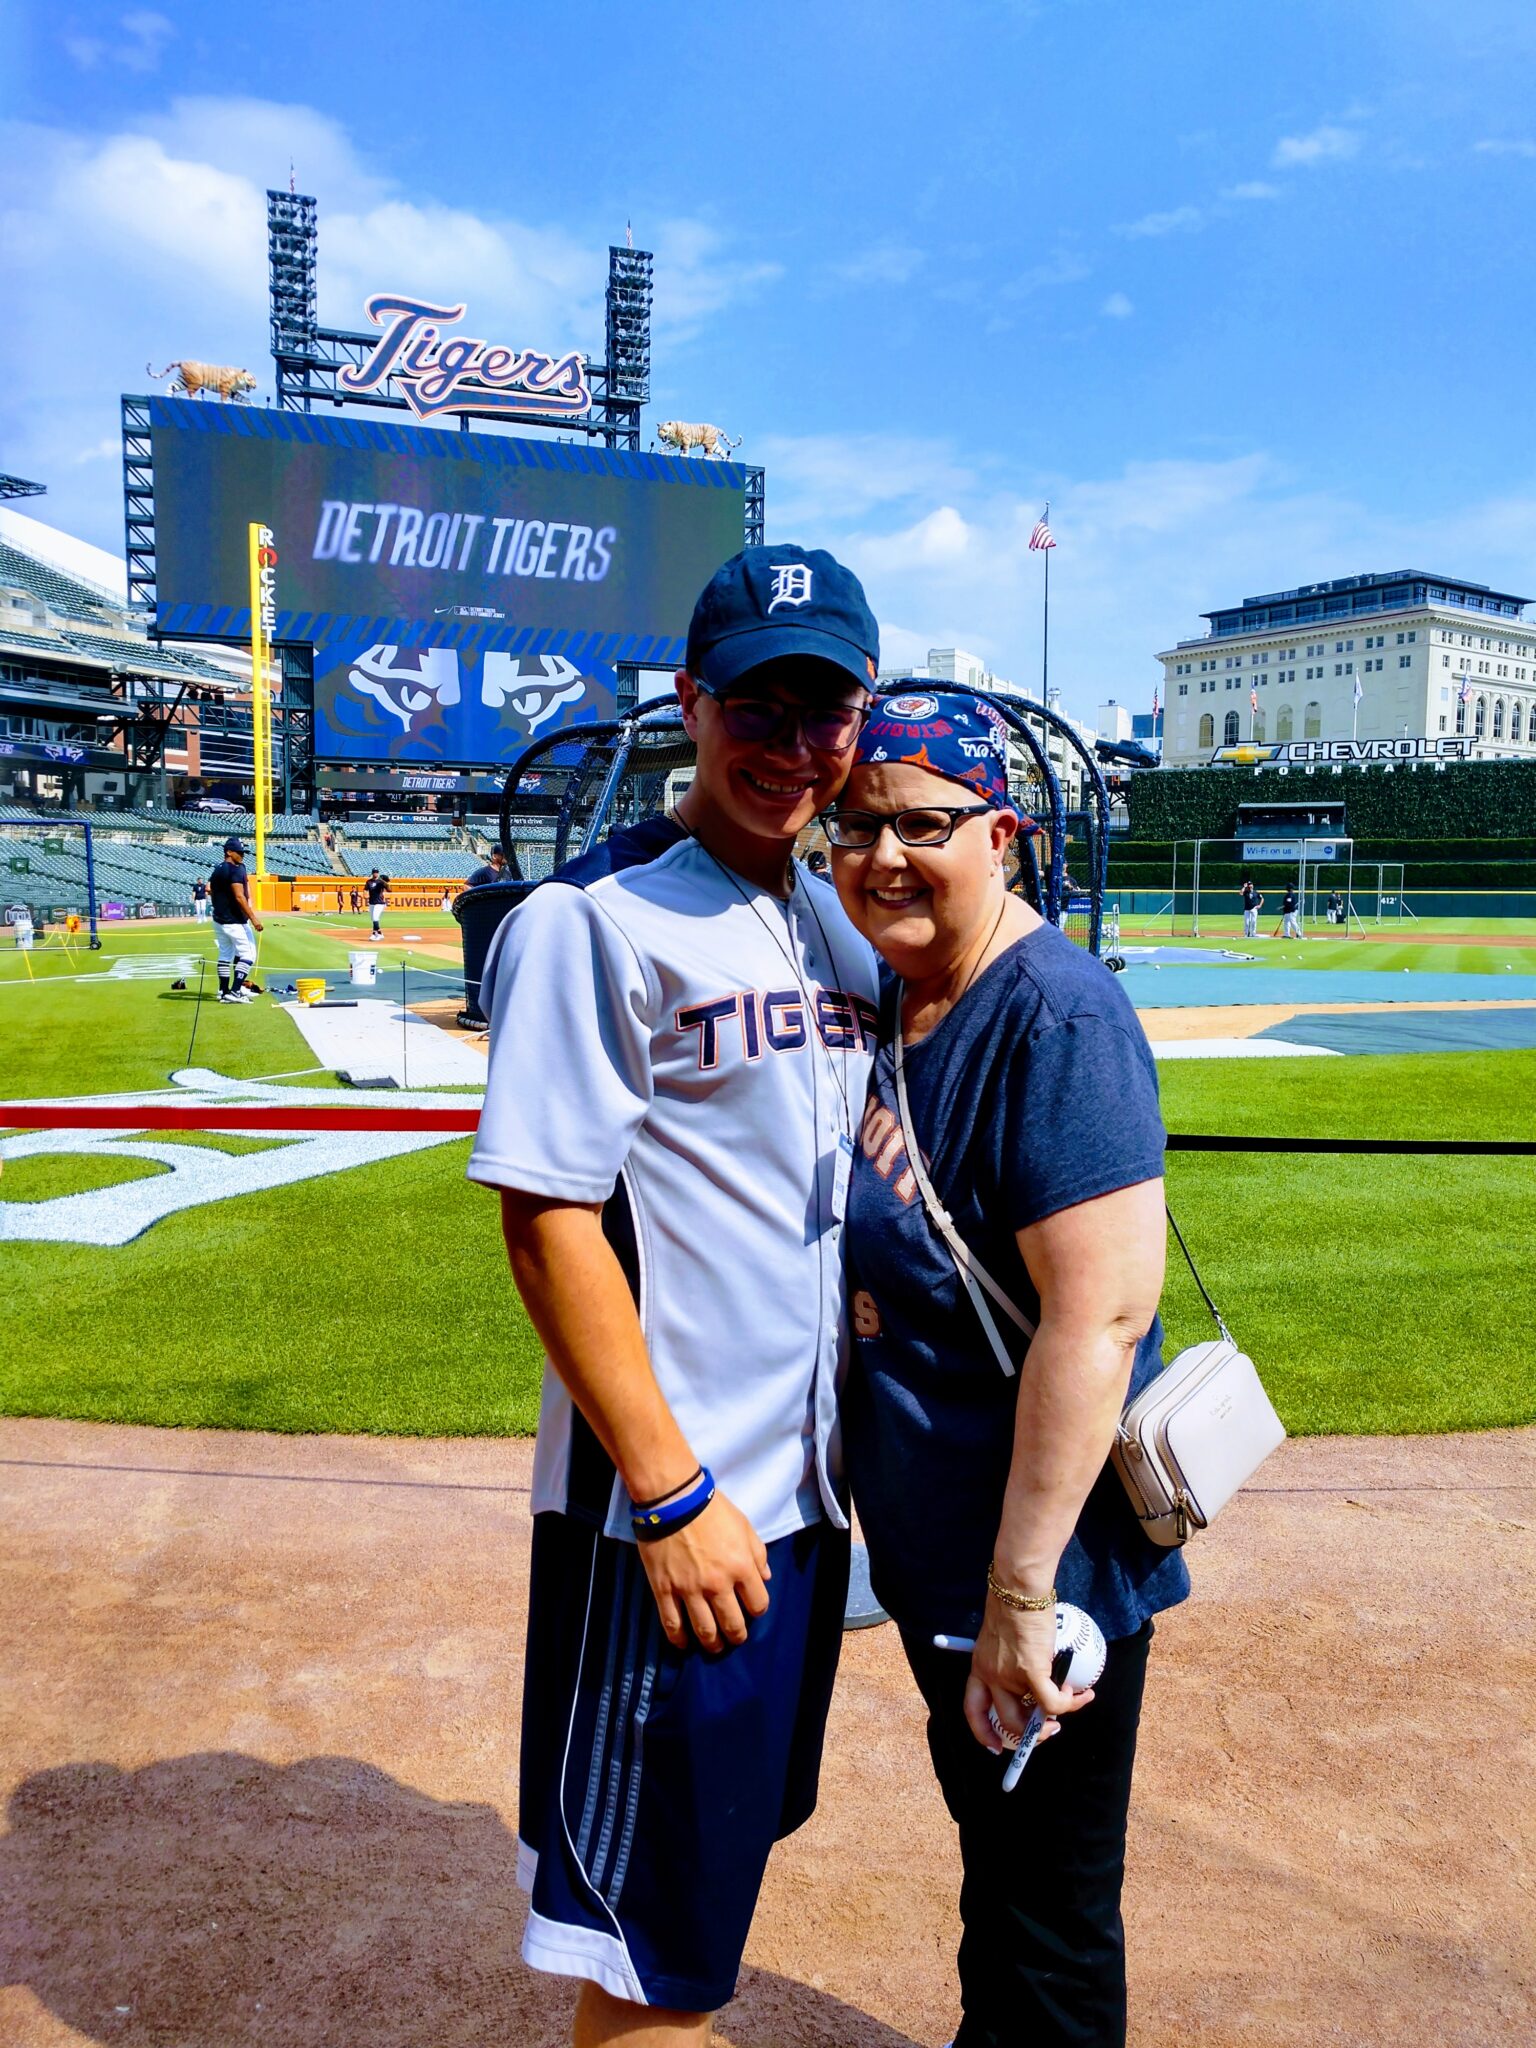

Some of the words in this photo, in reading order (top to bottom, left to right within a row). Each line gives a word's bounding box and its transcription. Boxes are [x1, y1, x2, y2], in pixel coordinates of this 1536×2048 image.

[338, 293, 591, 421] Tigers
[312, 499, 486, 571] DETROIT
[486, 516, 618, 582] TIGERS
[258, 527, 278, 644] ROCKET
[768, 563, 813, 614] D
[1287, 737, 1478, 761] CHEVROLET
[1254, 762, 1446, 776] FOUNTAIN
[402, 776, 433, 788] DETROIT
[432, 778, 456, 789] TIGERS
[486, 817, 513, 825] Toger
[1247, 846, 1268, 855] Wi-Fi
[1283, 847, 1292, 855] us
[1380, 897, 1397, 905] 412'
